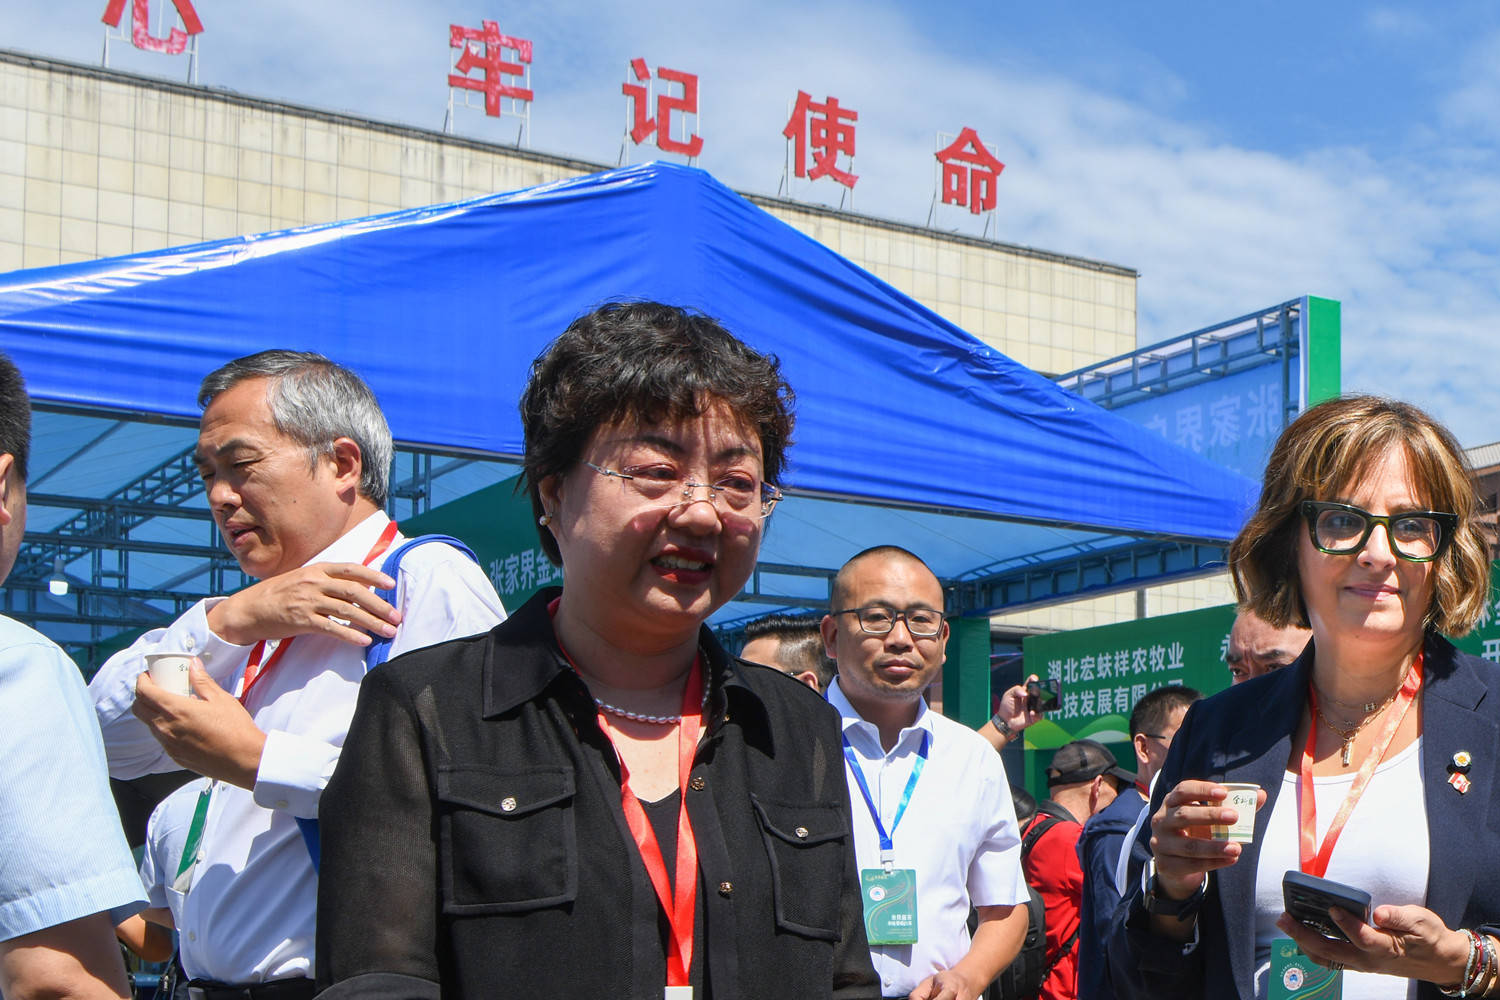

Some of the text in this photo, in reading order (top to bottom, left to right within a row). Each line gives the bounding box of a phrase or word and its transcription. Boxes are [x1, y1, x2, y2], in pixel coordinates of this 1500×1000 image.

[448, 20, 1005, 215] 牢记使命
[1048, 642, 1184, 684] 湖北宏蚨祥农牧业
[1048, 679, 1184, 721] 技发展有限
